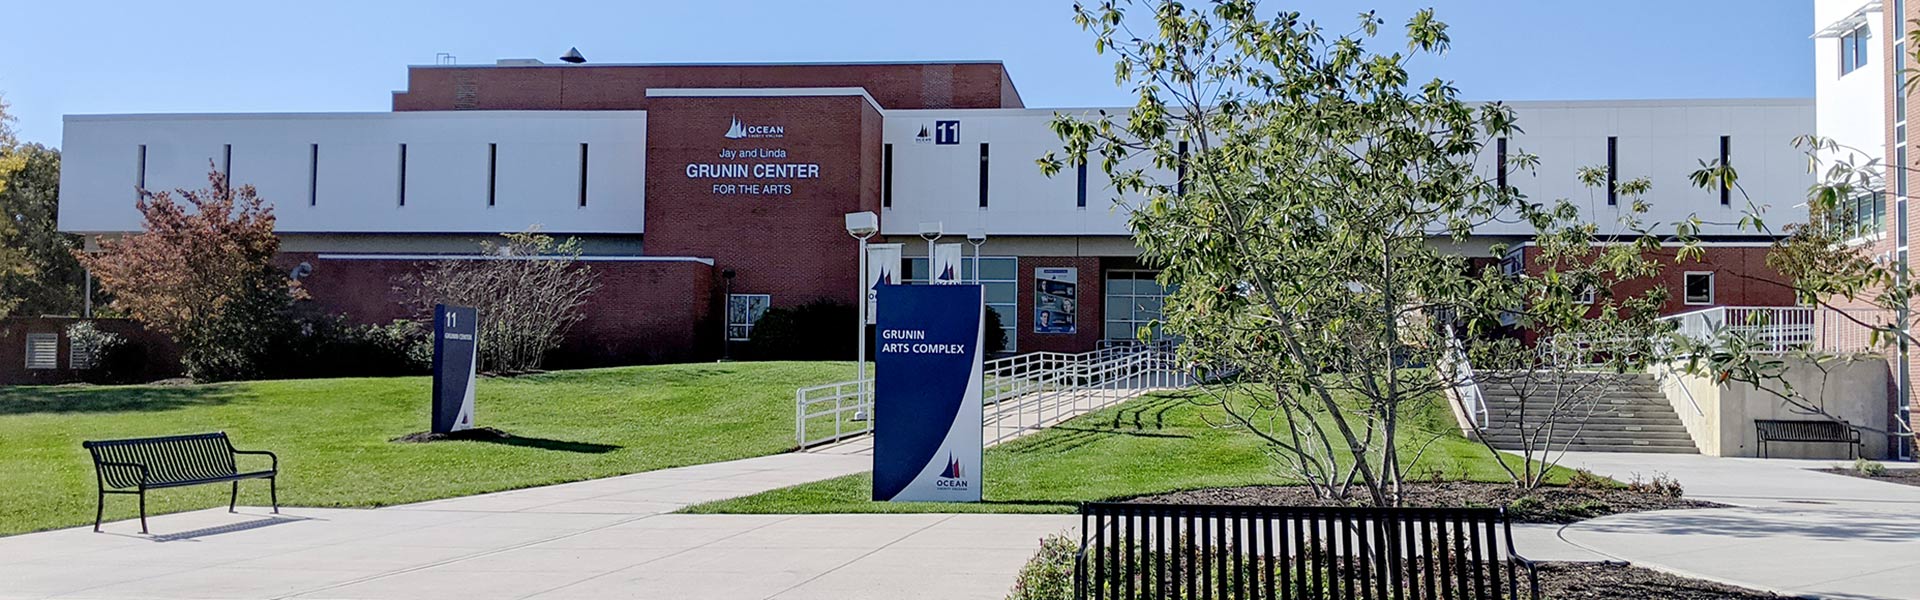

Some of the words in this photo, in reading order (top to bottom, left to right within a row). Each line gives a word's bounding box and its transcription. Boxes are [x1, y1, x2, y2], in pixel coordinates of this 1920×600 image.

[748, 126, 784, 134] OCEAN
[938, 123, 957, 142] 11
[719, 149, 737, 160] Jay
[739, 149, 757, 158] and
[760, 149, 786, 158] Linda
[686, 164, 748, 178] GRUNIN
[753, 164, 819, 178] CENTER
[713, 185, 735, 194] FOR
[738, 185, 759, 194] THE
[762, 184, 791, 194] ARTS
[446, 312, 456, 327] 11
[882, 330, 925, 339] GRUNIN
[882, 343, 909, 353] ARTS
[912, 344, 965, 354] COMPLEX
